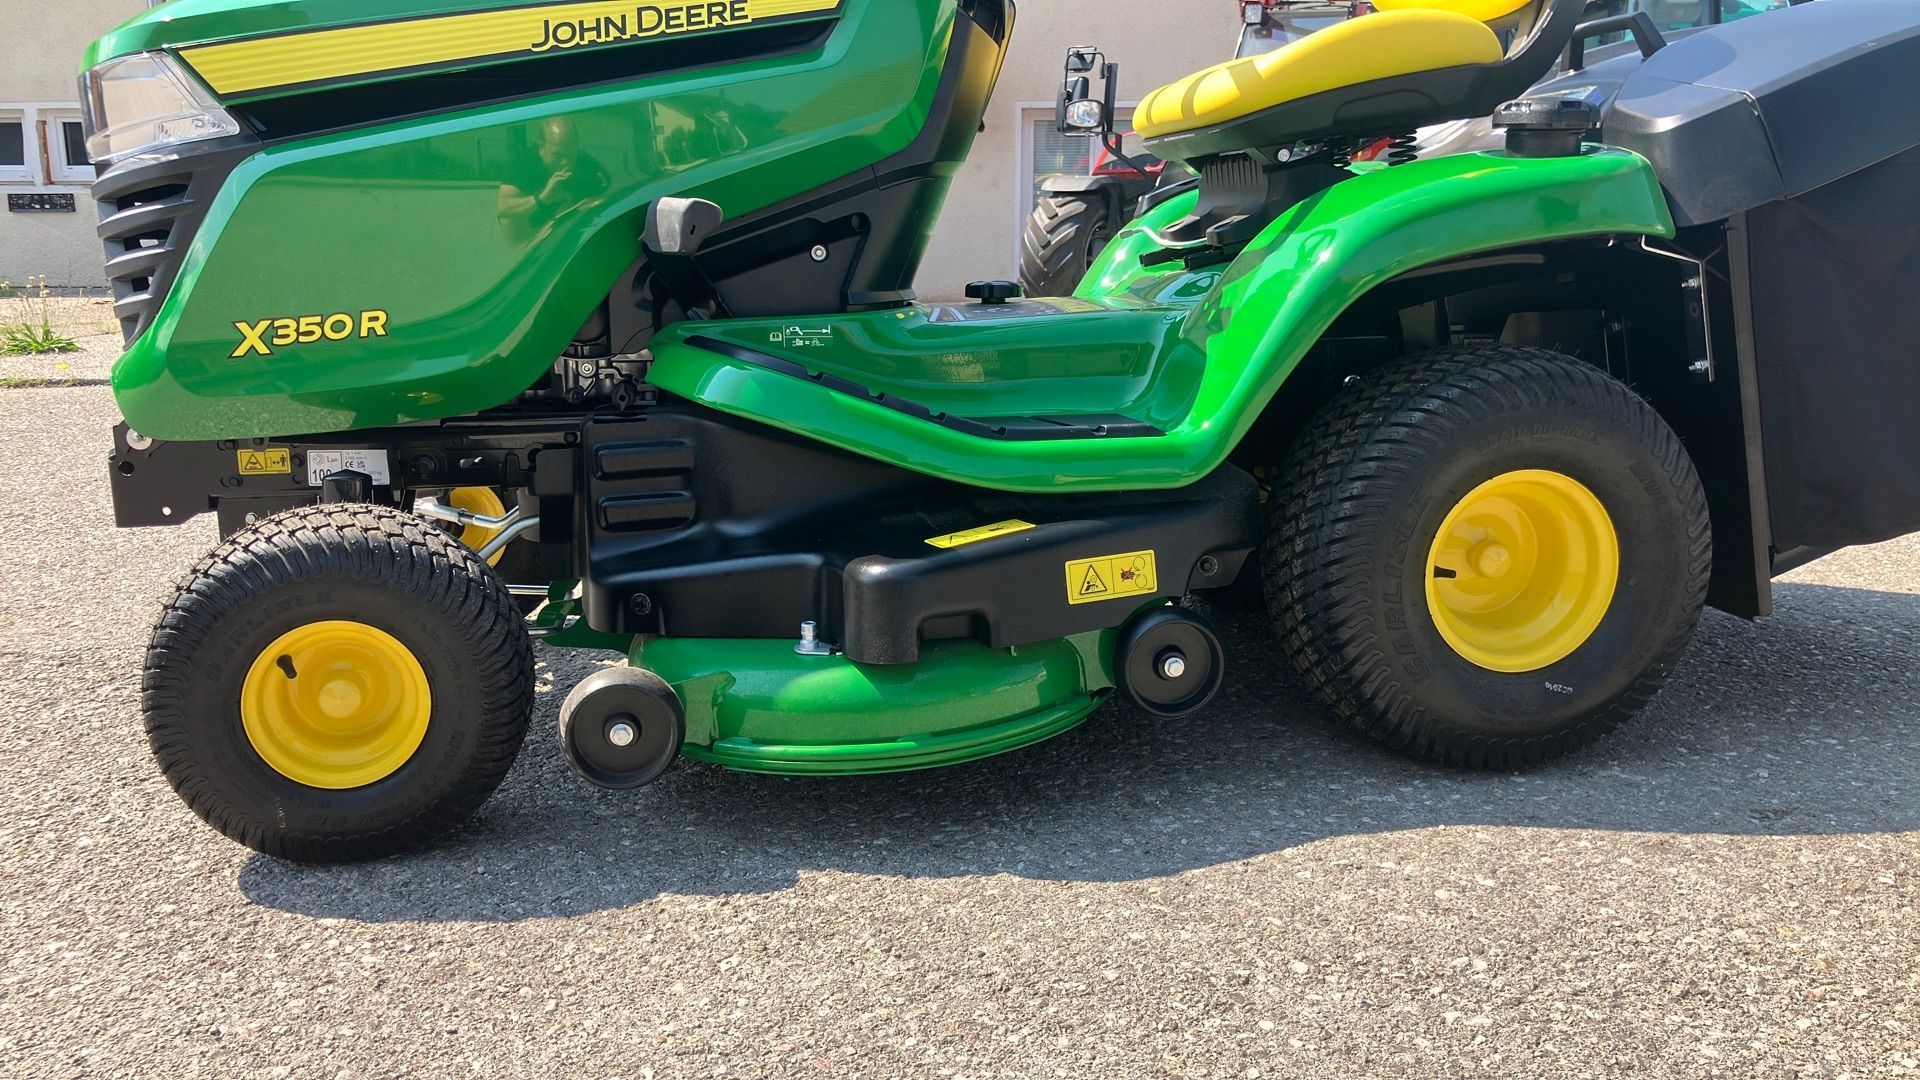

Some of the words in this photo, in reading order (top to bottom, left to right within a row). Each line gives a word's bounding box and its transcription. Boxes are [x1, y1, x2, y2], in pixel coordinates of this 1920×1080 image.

[531, 14, 627, 49] JOHN
[636, 0, 749, 34] DEERE
[228, 312, 354, 358] X350
[359, 309, 388, 338] R
